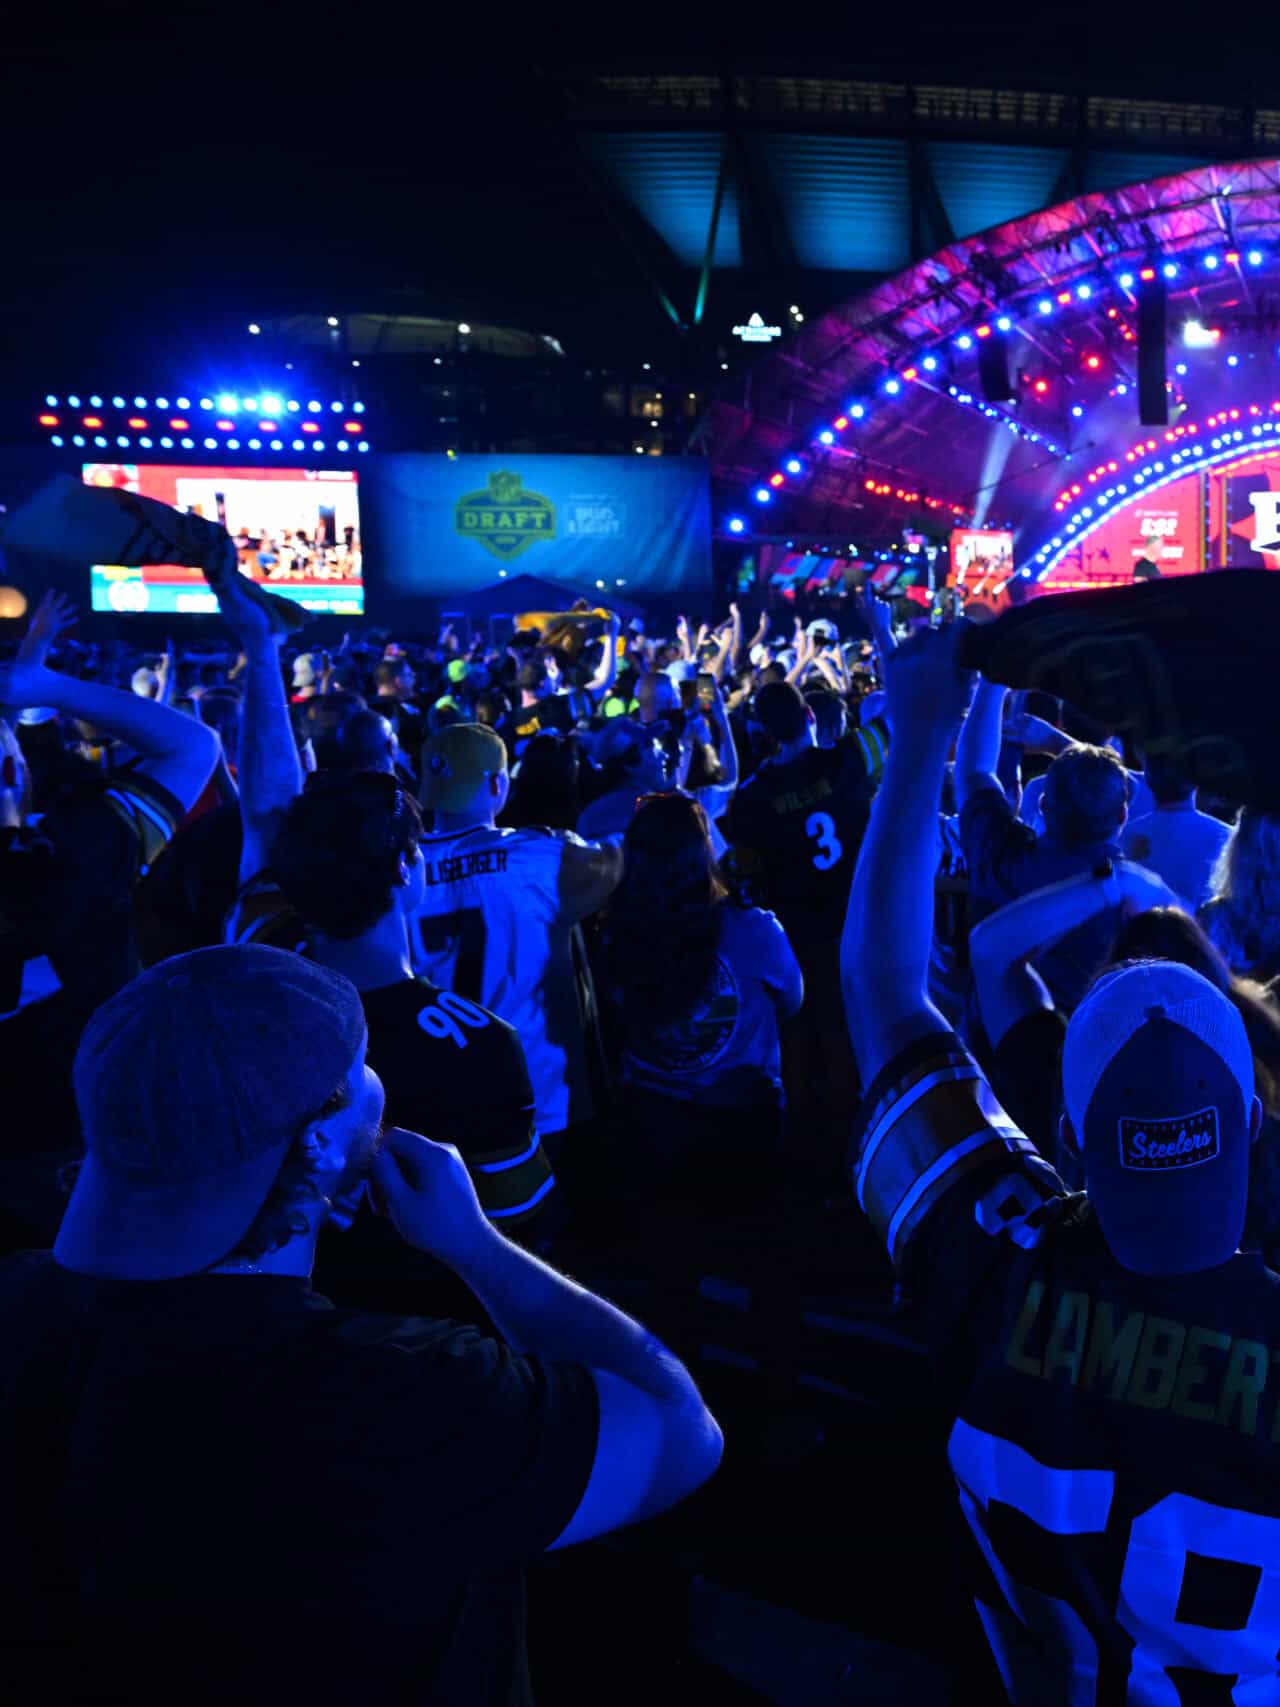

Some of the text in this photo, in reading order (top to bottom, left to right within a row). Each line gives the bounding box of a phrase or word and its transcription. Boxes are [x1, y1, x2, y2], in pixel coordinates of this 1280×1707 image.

[463, 512, 546, 528] DRAFT
[804, 810, 844, 872] 3
[426, 849, 507, 885] LISBERGER
[420, 907, 486, 998] 7
[416, 991, 491, 1050] 90
[1128, 1128, 1213, 1160] Steelers
